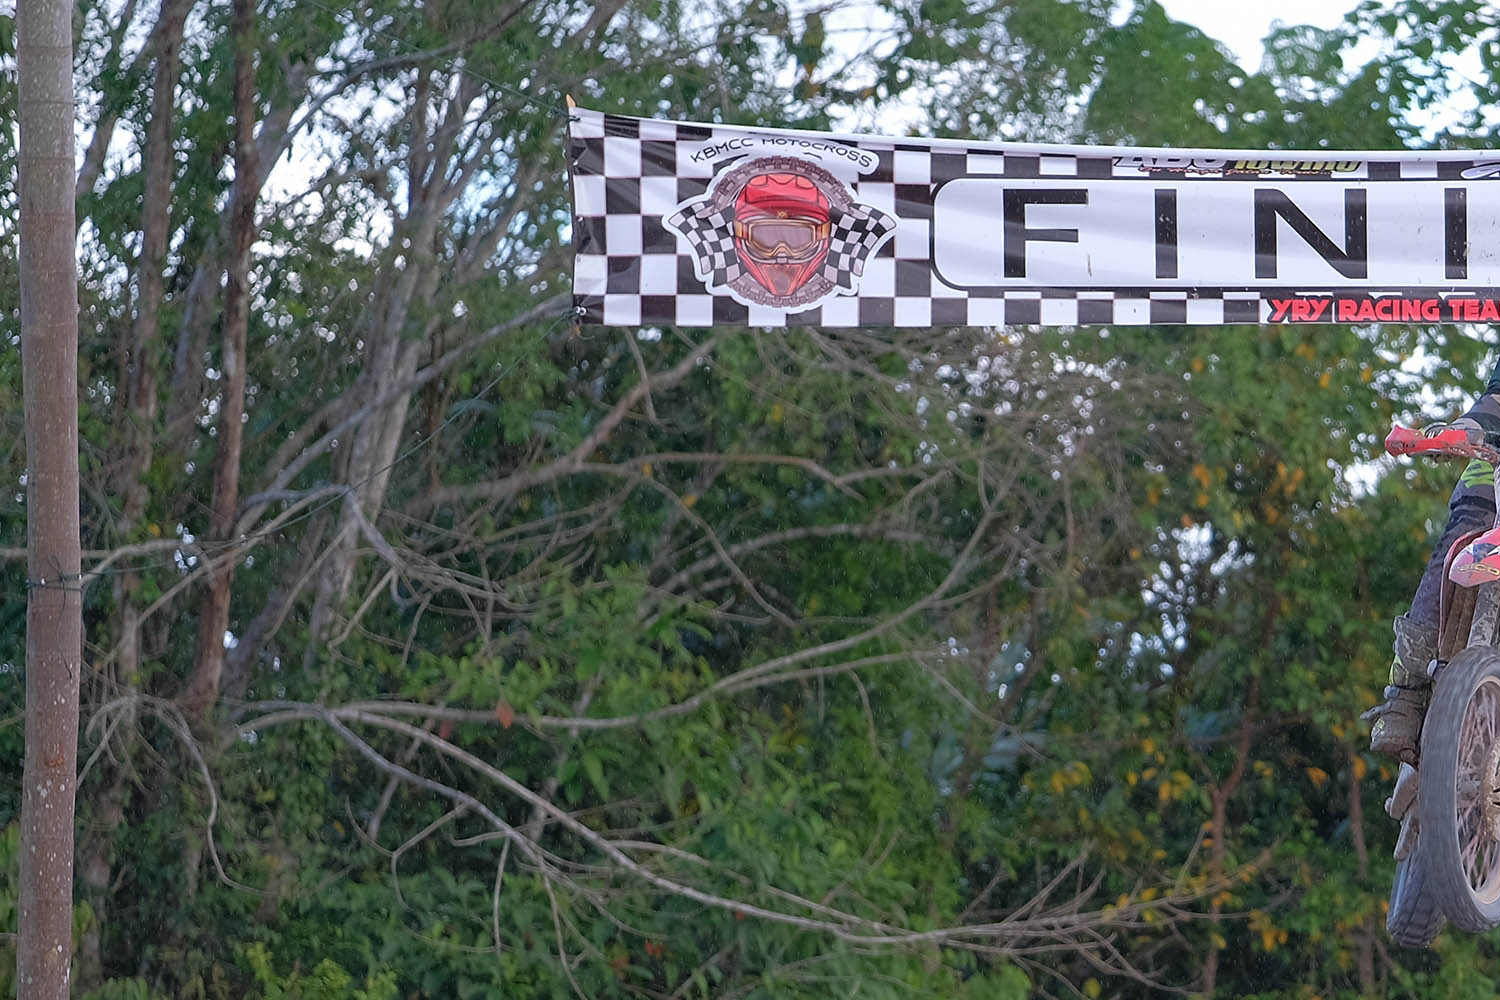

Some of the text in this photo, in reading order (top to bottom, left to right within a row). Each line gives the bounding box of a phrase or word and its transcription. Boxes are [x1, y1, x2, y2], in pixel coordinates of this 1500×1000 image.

[691, 138, 873, 168] KBMCC MOTOCROSS
[1271, 299, 1330, 322] YRY
[1338, 299, 1441, 322] RACING
